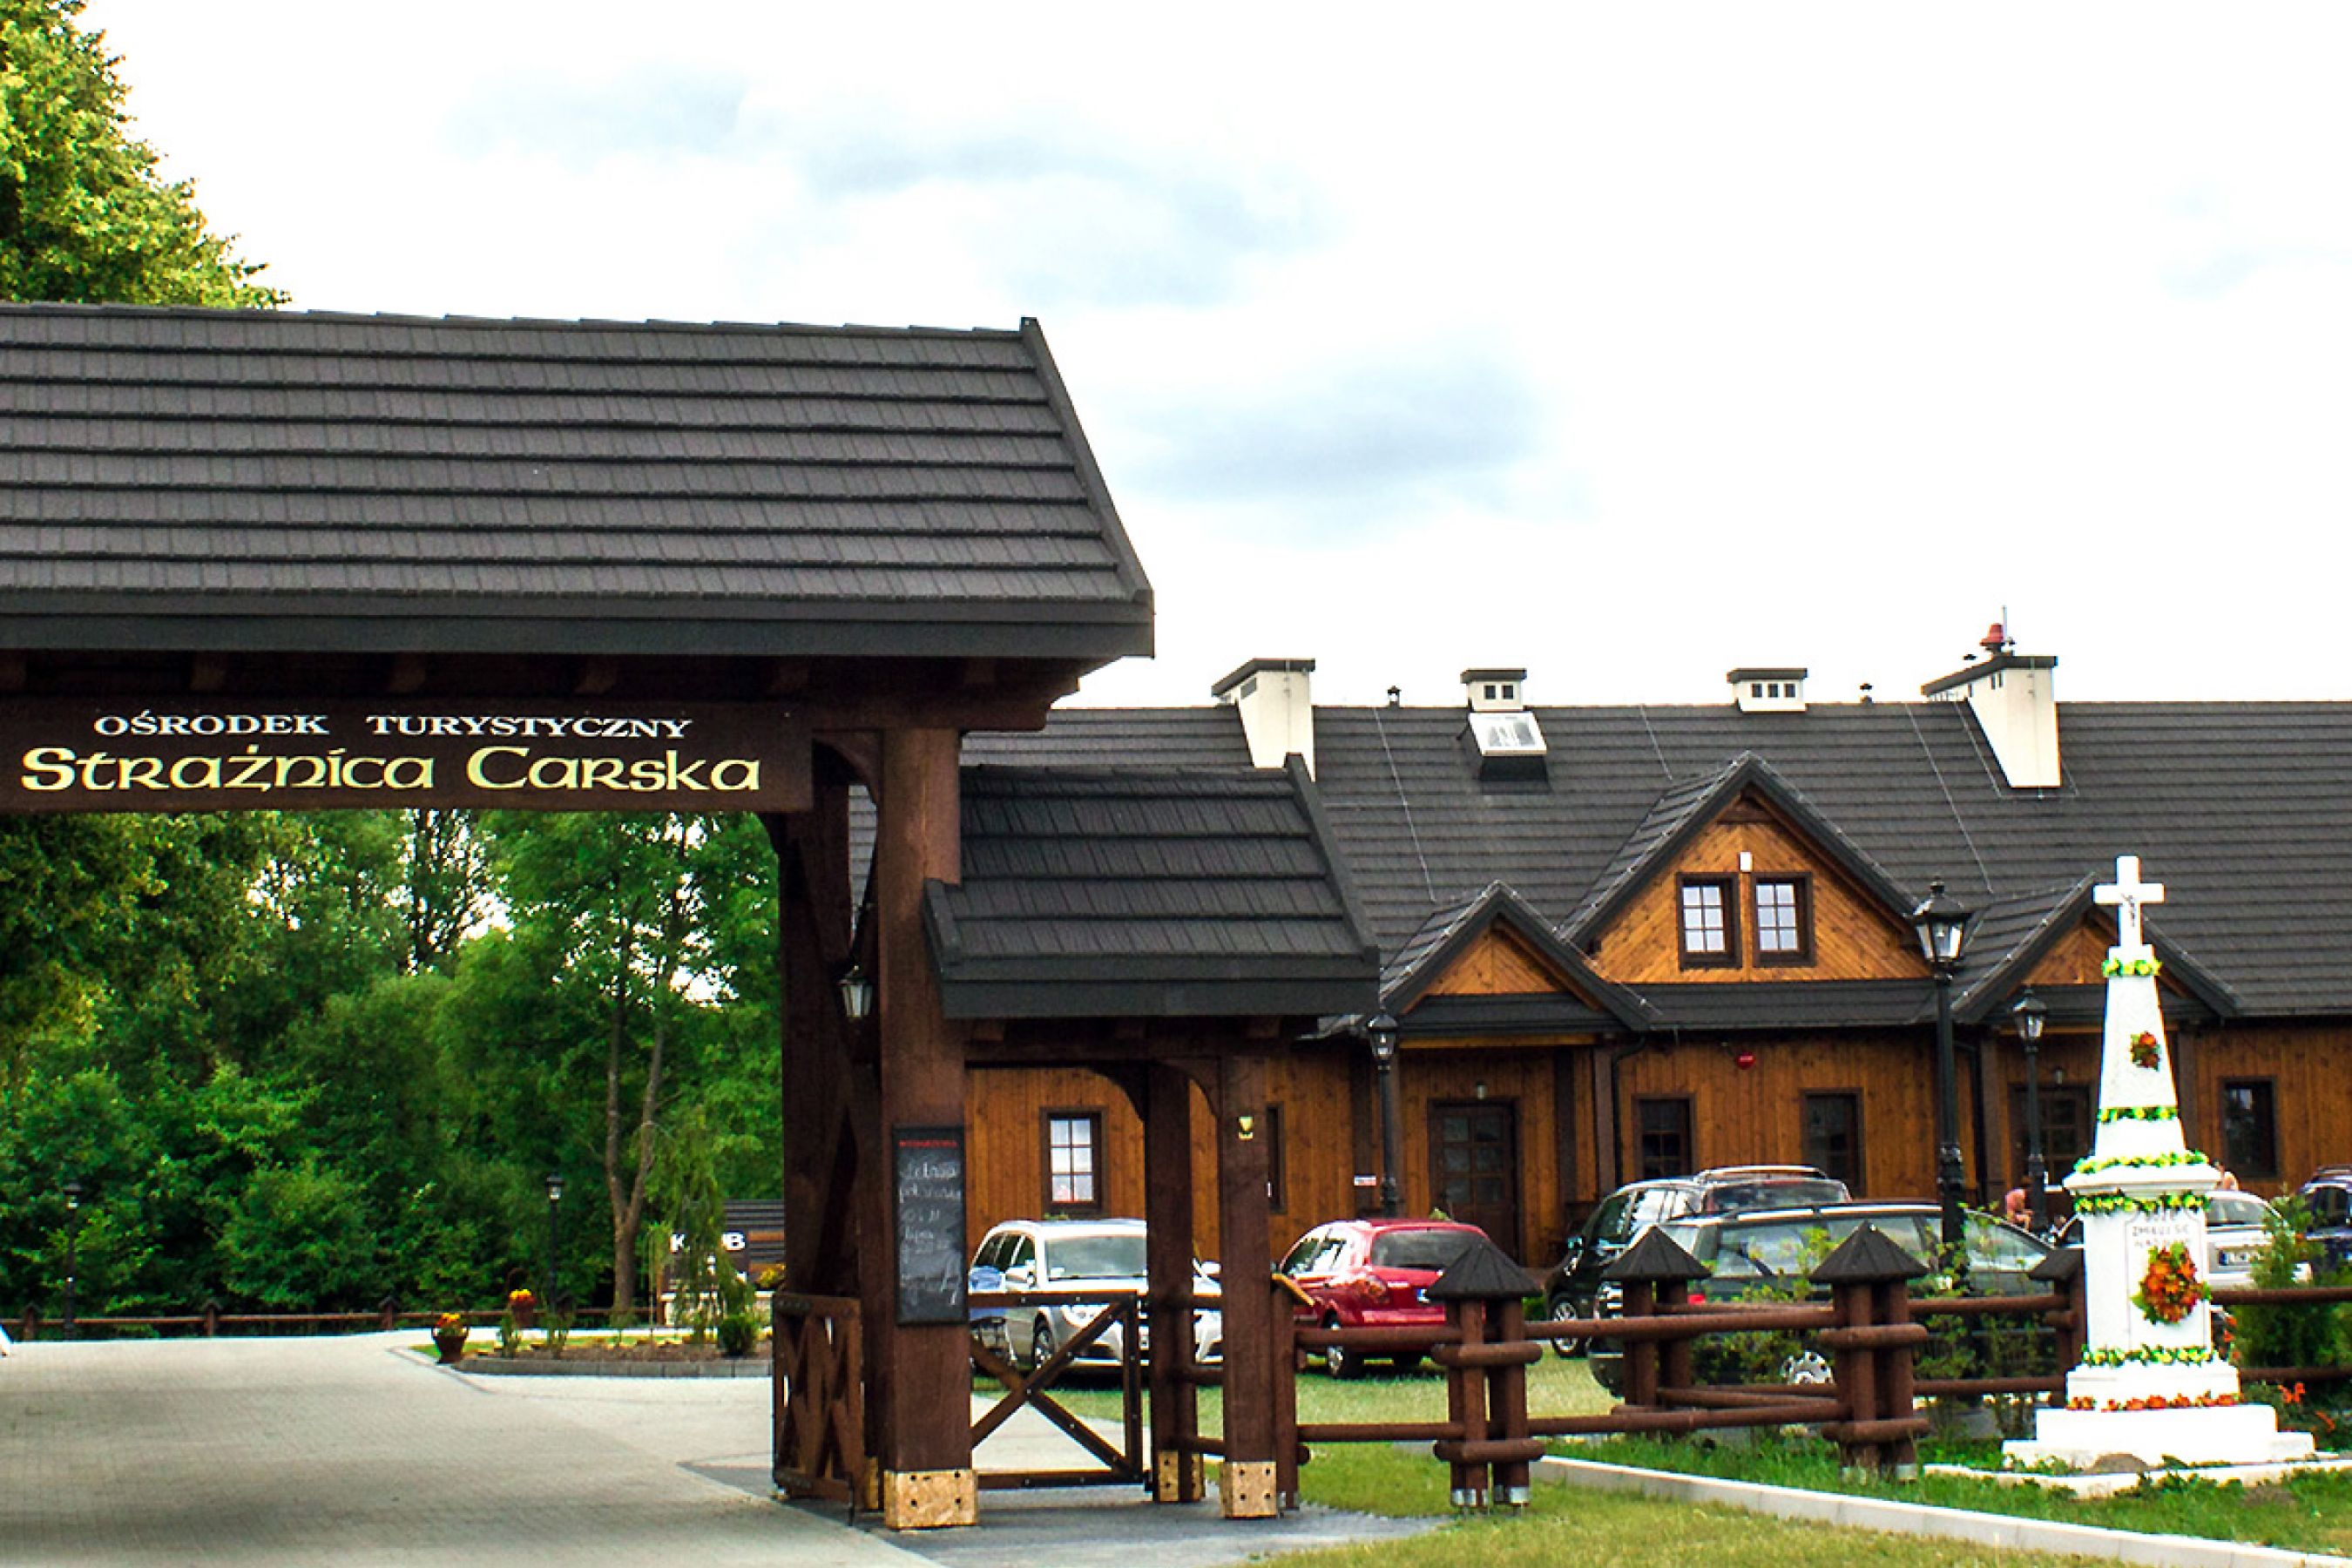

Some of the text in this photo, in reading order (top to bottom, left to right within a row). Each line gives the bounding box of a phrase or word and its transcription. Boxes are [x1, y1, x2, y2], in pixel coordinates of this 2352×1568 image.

[93, 709, 693, 739] OŚRODEK TURYSTYCZNY
[21, 744, 760, 792] Strażnica Carska
